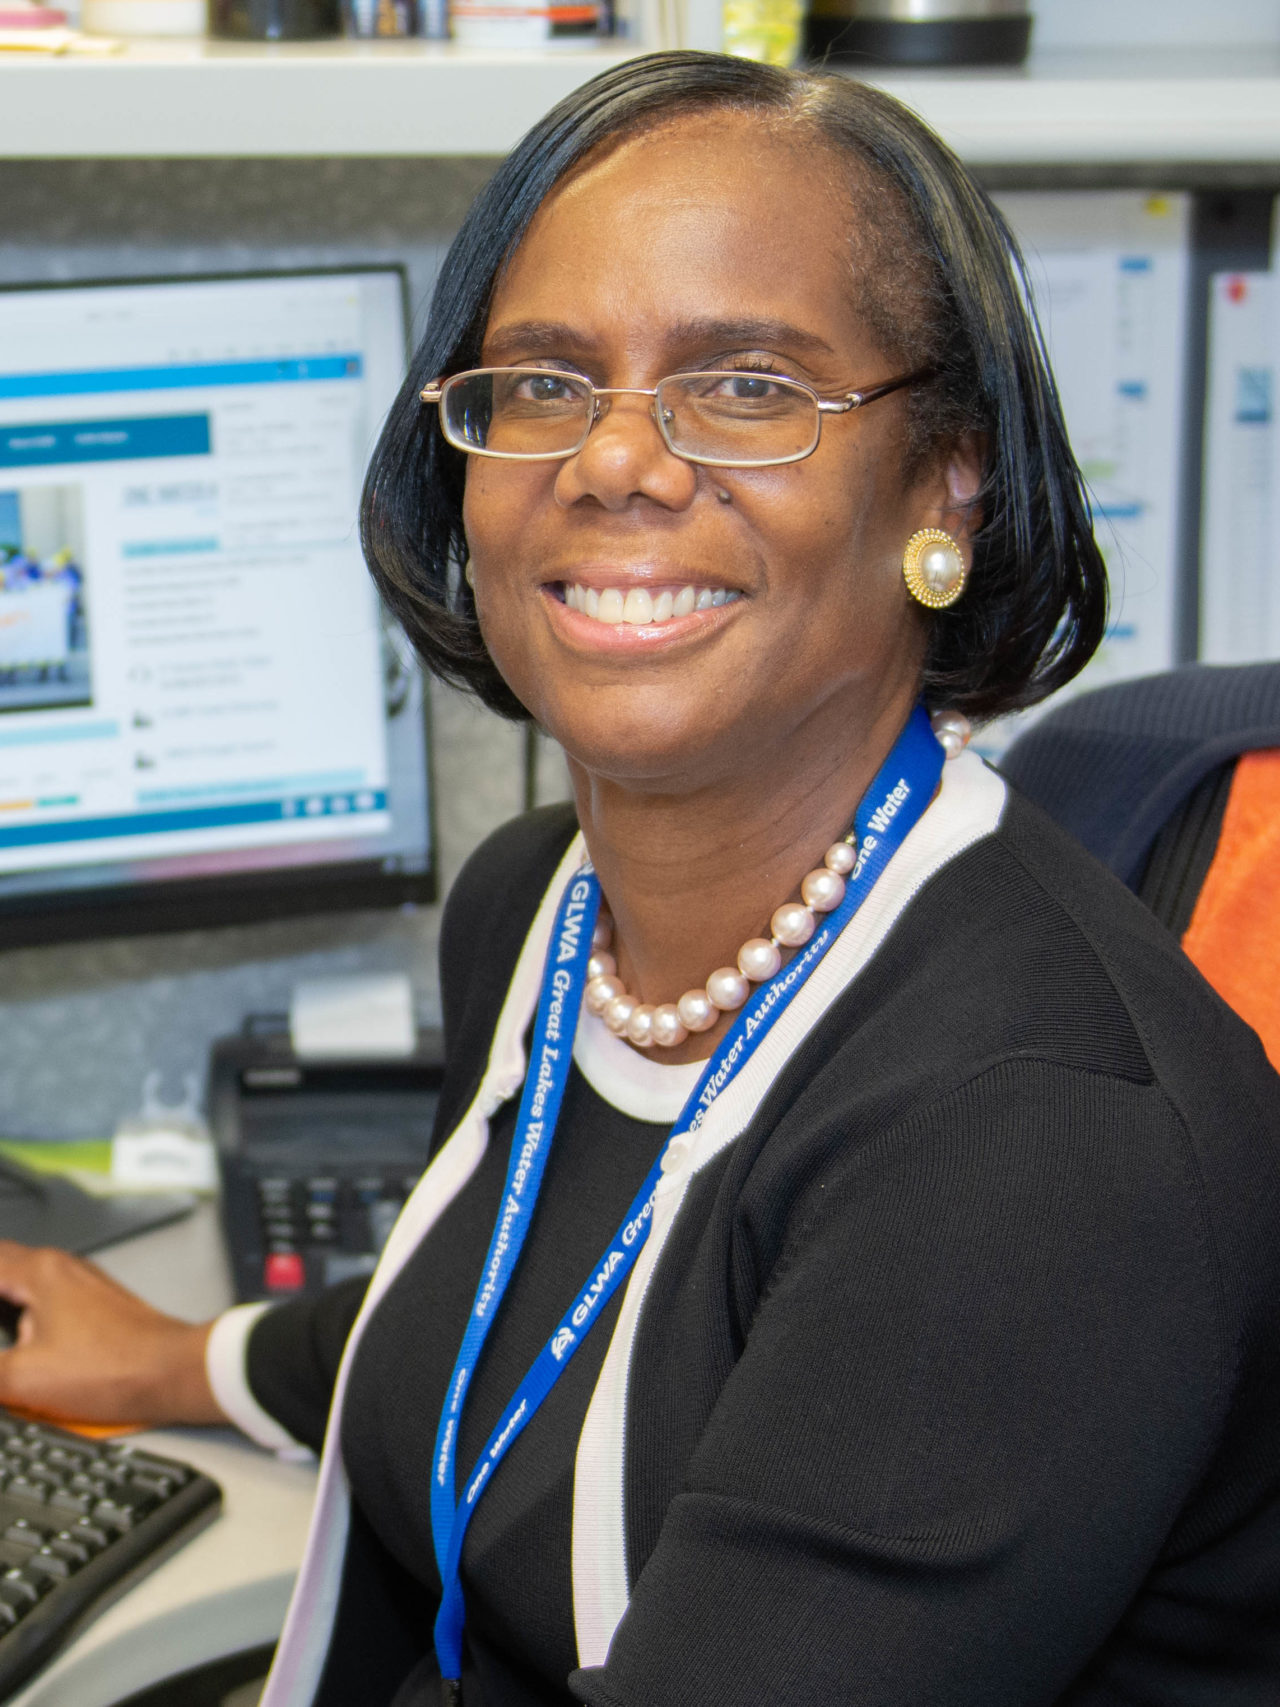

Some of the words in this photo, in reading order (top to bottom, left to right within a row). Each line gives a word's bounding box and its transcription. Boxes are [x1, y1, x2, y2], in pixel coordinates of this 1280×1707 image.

[867, 778, 910, 833] Water
[557, 880, 589, 963] GLWA
[546, 969, 571, 1042] Great
[698, 1035, 744, 1107] Water
[745, 930, 829, 1040] Authority
[530, 1044, 559, 1119] Lakes
[511, 1121, 543, 1196] Water
[476, 1194, 520, 1317] Authority
[571, 1251, 624, 1327] GLWA
